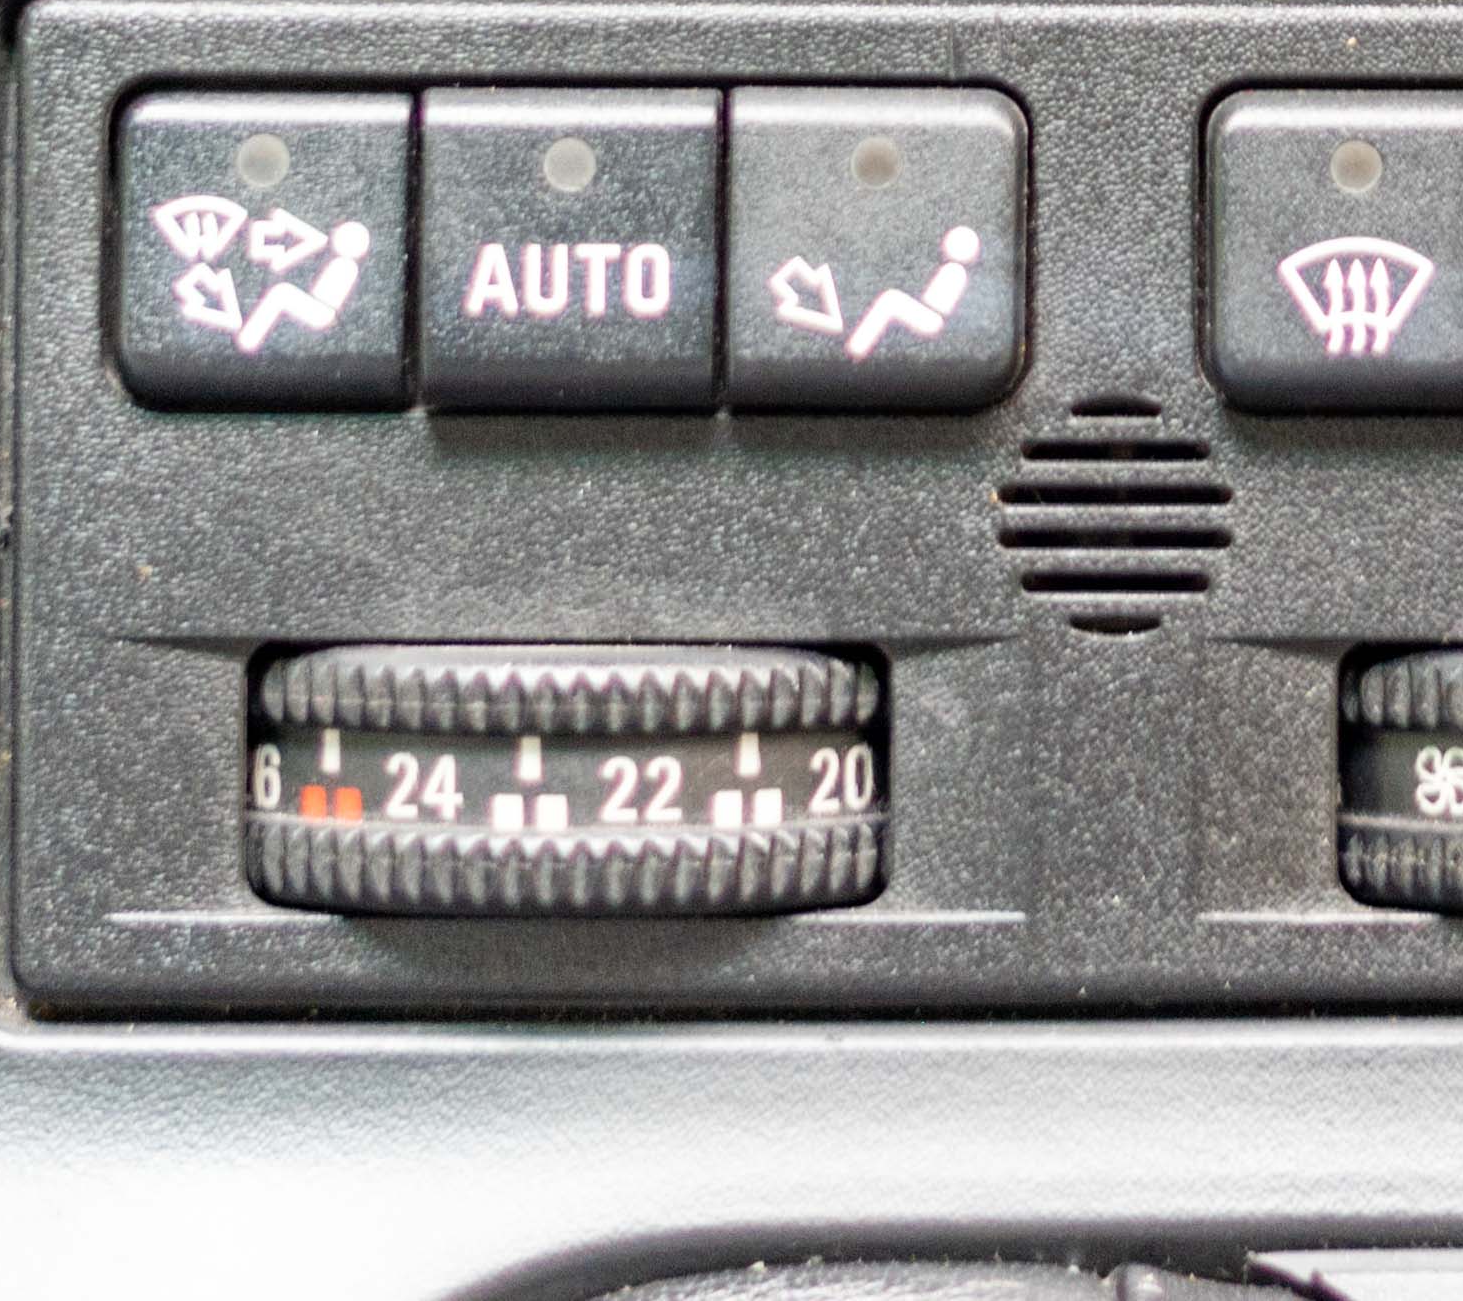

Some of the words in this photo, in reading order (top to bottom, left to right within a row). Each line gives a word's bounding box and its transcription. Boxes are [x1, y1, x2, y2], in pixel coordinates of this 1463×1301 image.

[464, 242, 671, 318] AUTO
[253, 743, 282, 810] 6
[384, 752, 464, 819] 24
[600, 755, 683, 822] 22
[808, 744, 874, 814] 20
